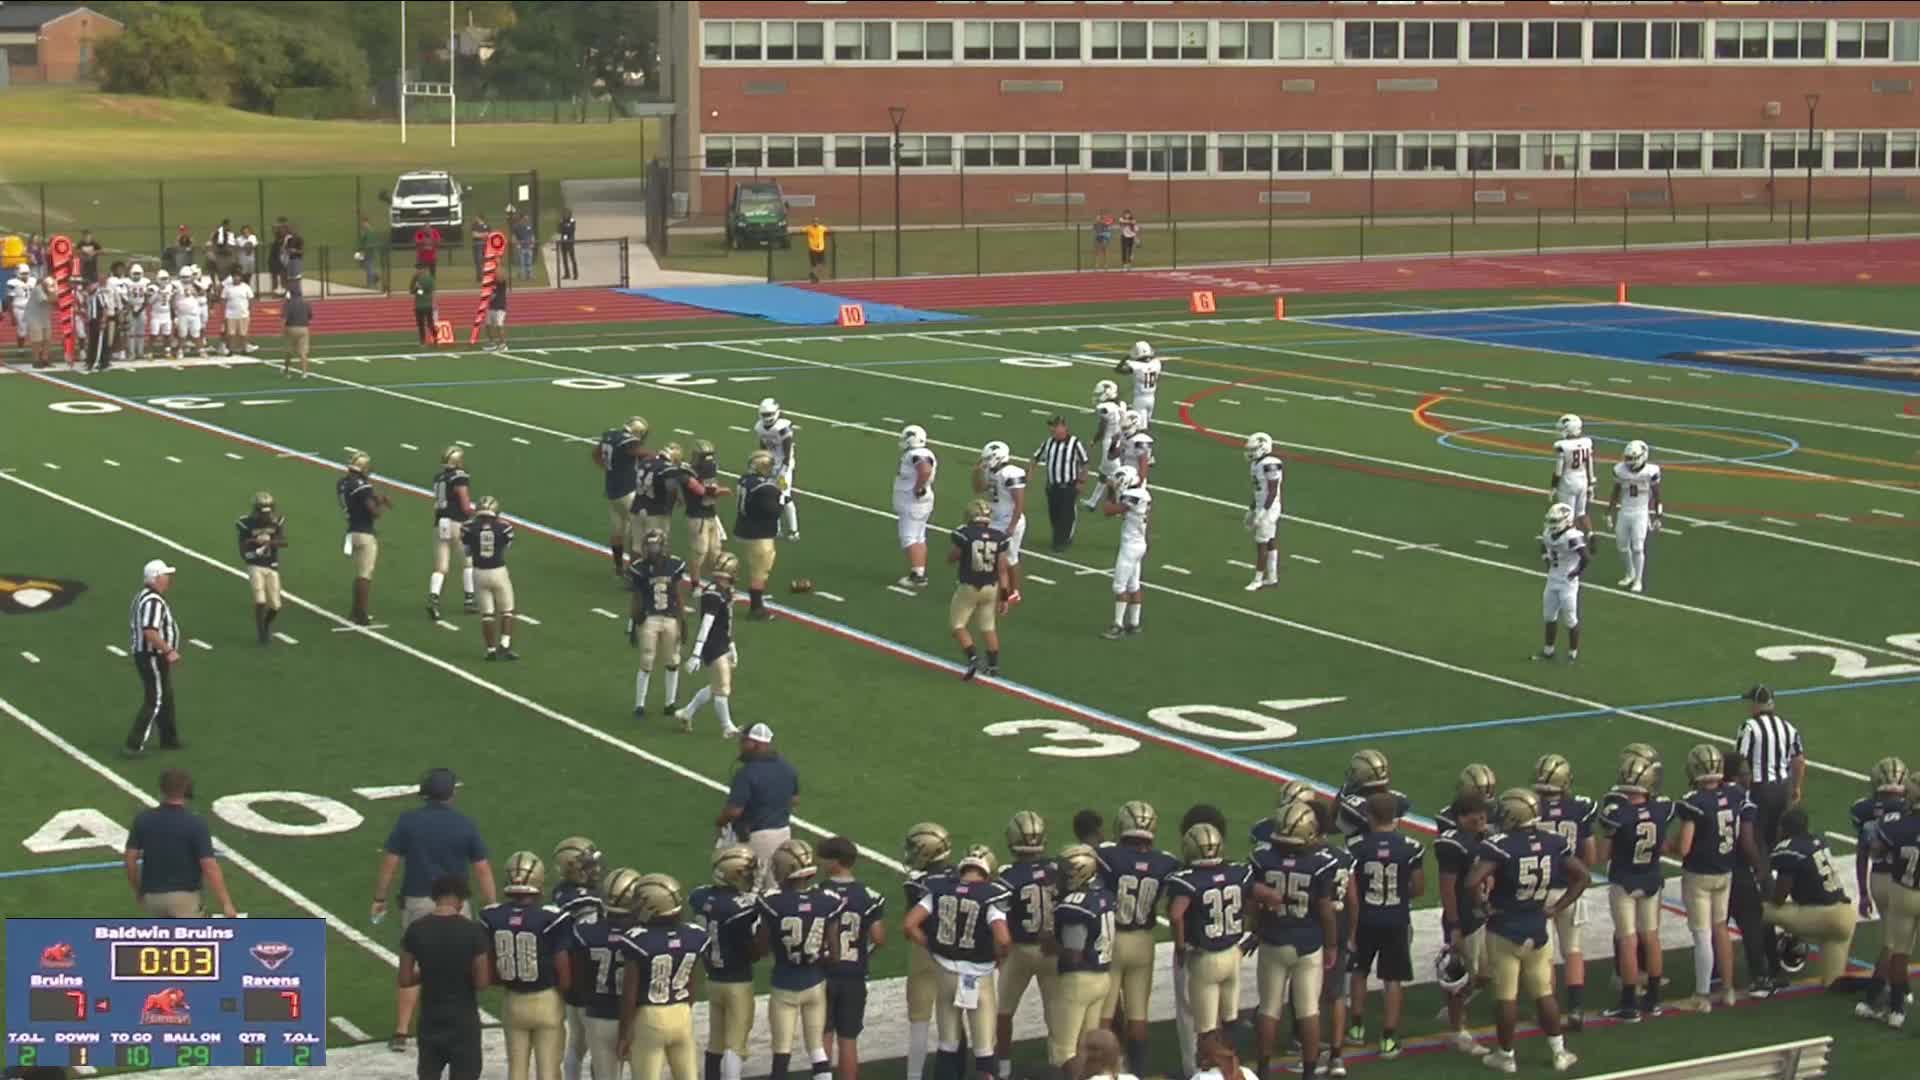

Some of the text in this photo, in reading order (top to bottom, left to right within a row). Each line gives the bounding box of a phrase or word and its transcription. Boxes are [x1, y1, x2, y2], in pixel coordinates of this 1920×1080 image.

[845, 307, 861, 322] 10
[1632, 821, 1657, 864] 2
[1116, 874, 1159, 926] 60
[1364, 861, 1401, 906] 31
[1515, 854, 1551, 901] 51
[936, 895, 981, 949] 87
[1203, 884, 1243, 939] 32
[648, 952, 697, 1004] 84
